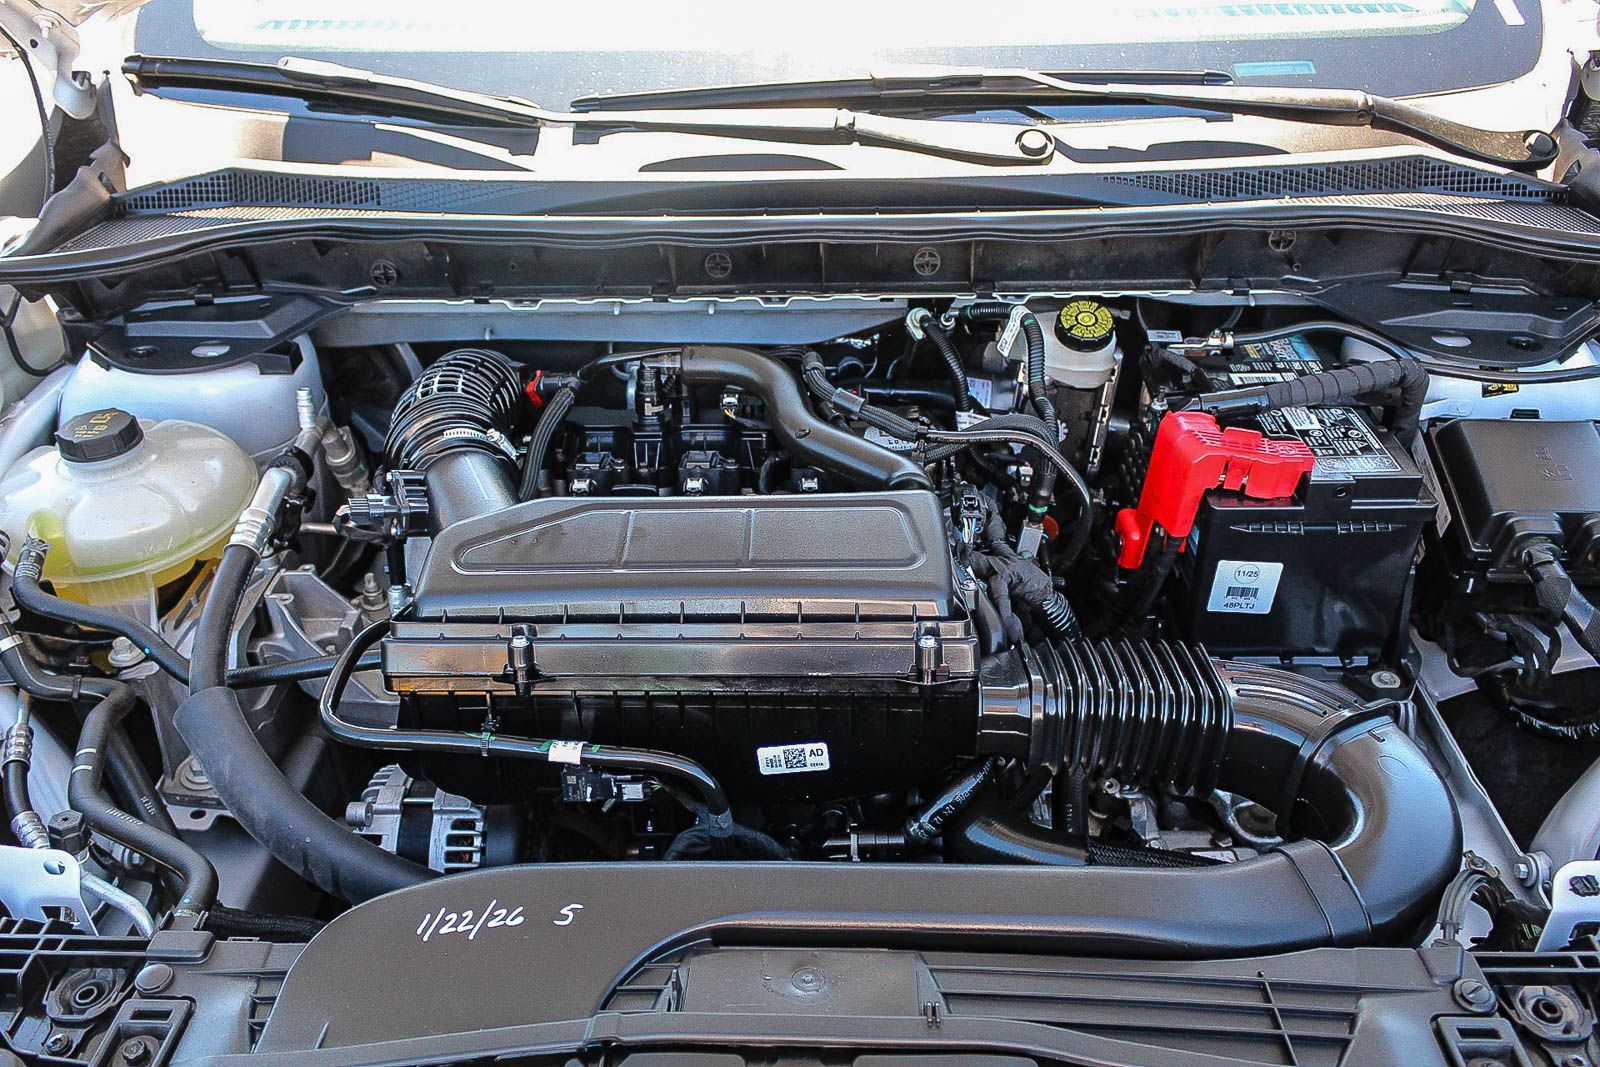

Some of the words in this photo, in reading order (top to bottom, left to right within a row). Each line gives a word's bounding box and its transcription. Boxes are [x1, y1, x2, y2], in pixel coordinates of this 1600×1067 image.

[1237, 570, 1259, 578] 11/25
[808, 748, 824, 758] AD
[416, 898, 525, 942] 1/22/26
